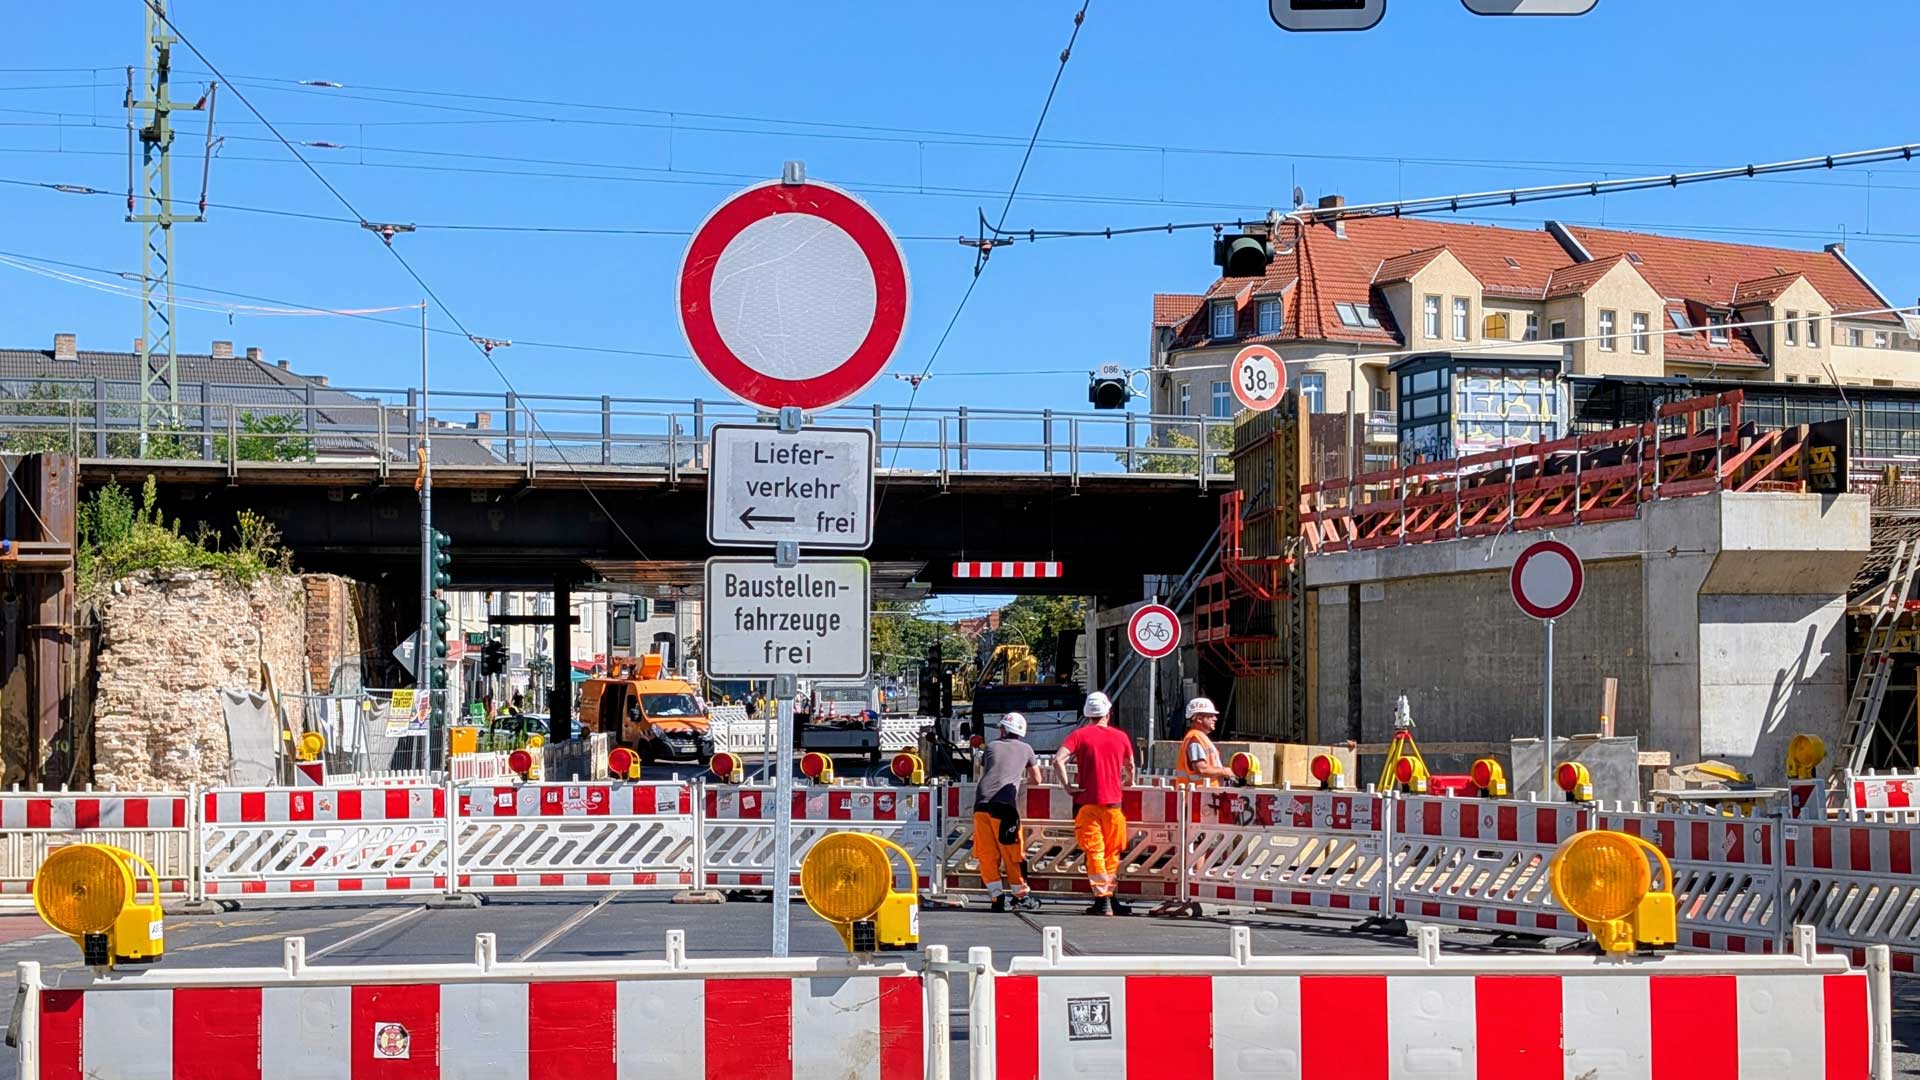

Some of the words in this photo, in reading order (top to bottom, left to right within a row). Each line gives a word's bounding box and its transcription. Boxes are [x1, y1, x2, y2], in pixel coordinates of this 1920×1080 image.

[1103, 365, 1119, 374] 086
[754, 441, 835, 466] Liefer-
[746, 476, 841, 499] verkehr
[816, 510, 855, 534] frei
[725, 573, 850, 598] Baustellen-
[734, 606, 840, 635] fahrzeuge
[763, 639, 811, 664] frei
